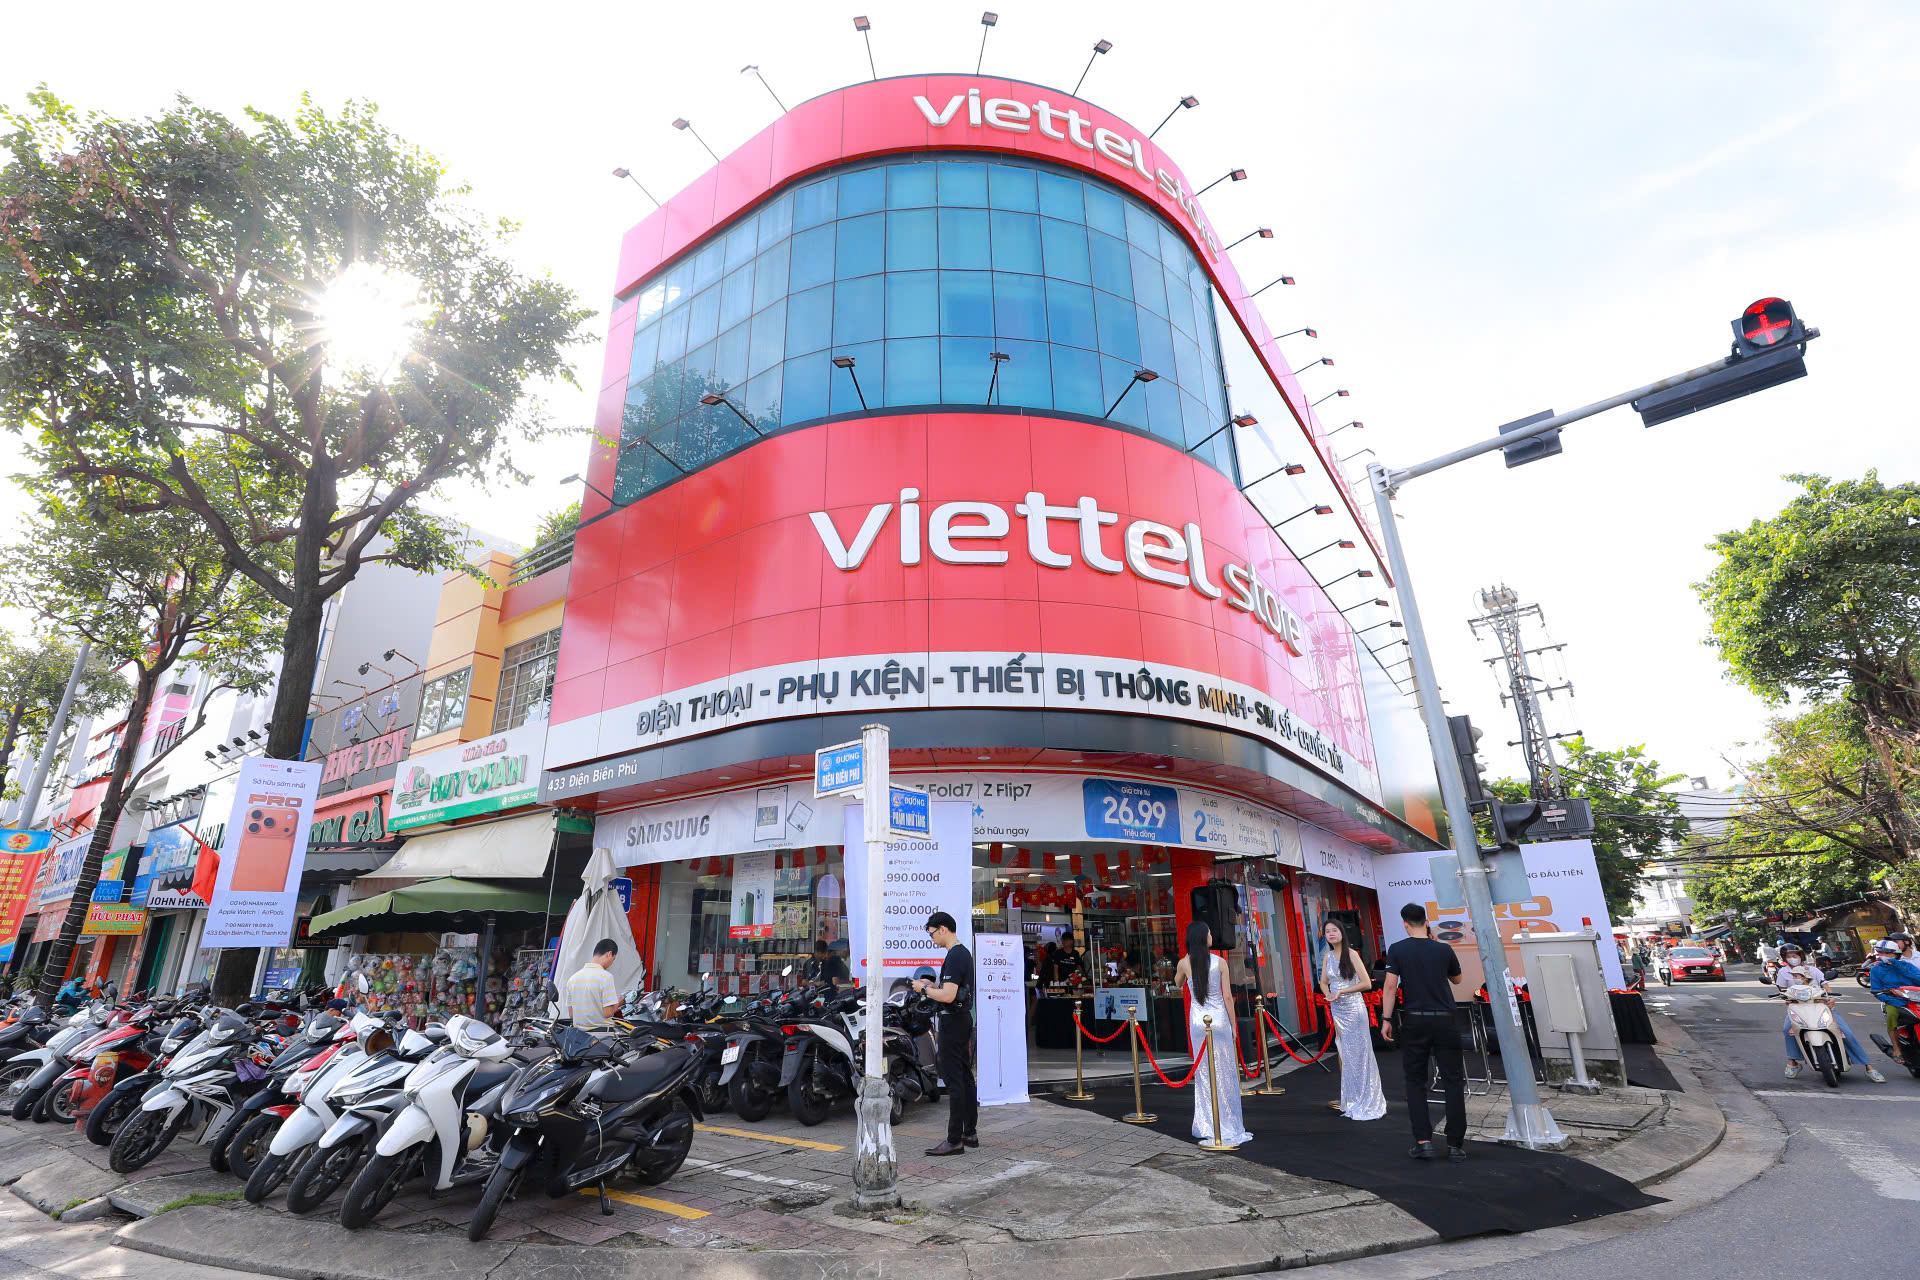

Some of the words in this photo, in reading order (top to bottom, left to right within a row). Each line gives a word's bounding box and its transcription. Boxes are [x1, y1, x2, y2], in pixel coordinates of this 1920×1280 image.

[913, 88, 1154, 182] viettel
[1155, 167, 1219, 265] store
[809, 487, 1221, 600] viettel
[1223, 563, 1303, 658] store
[636, 700, 682, 736] ĐIỆN
[688, 683, 753, 723] THOẠI
[777, 671, 840, 705] PHỤ
[850, 659, 925, 701] KIỆN
[950, 652, 1044, 693] THIẾT
[1056, 667, 1085, 701] BỊ
[1095, 667, 1192, 706] THÔNG
[1197, 684, 1248, 720] MINH
[429, 769, 469, 804] HUY
[467, 754, 528, 795] QUÂN
[547, 776, 565, 792] 433
[568, 772, 590, 790] Điện
[592, 766, 614, 783] Biên
[617, 760, 638, 777] Phủ
[849, 763, 861, 782] PHỦ
[248, 793, 303, 808] PRO
[928, 783, 974, 798] Fold7
[983, 783, 993, 797] Z
[996, 782, 1032, 802] Flip7
[348, 795, 386, 843] GÀ
[1103, 796, 1166, 829] 26.99
[1207, 813, 1225, 829] Triệu
[626, 814, 711, 848] SAMSUNG
[973, 826, 985, 836] Sở
[986, 826, 1005, 836] hữu
[1005, 828, 1030, 838] ngay
[1123, 828, 1139, 839] Triệu
[1139, 828, 1156, 840] đồng
[1193, 809, 1208, 843] 2
[1208, 827, 1228, 846] đồng
[1561, 868, 1584, 877] TIÊN
[149, 896, 176, 906] JOHN
[177, 897, 205, 907] HENR
[887, 890, 909, 898] iPhone
[218, 909, 236, 917] Apple
[817, 911, 839, 919] PRO
[982, 957, 1007, 966] 23.990
